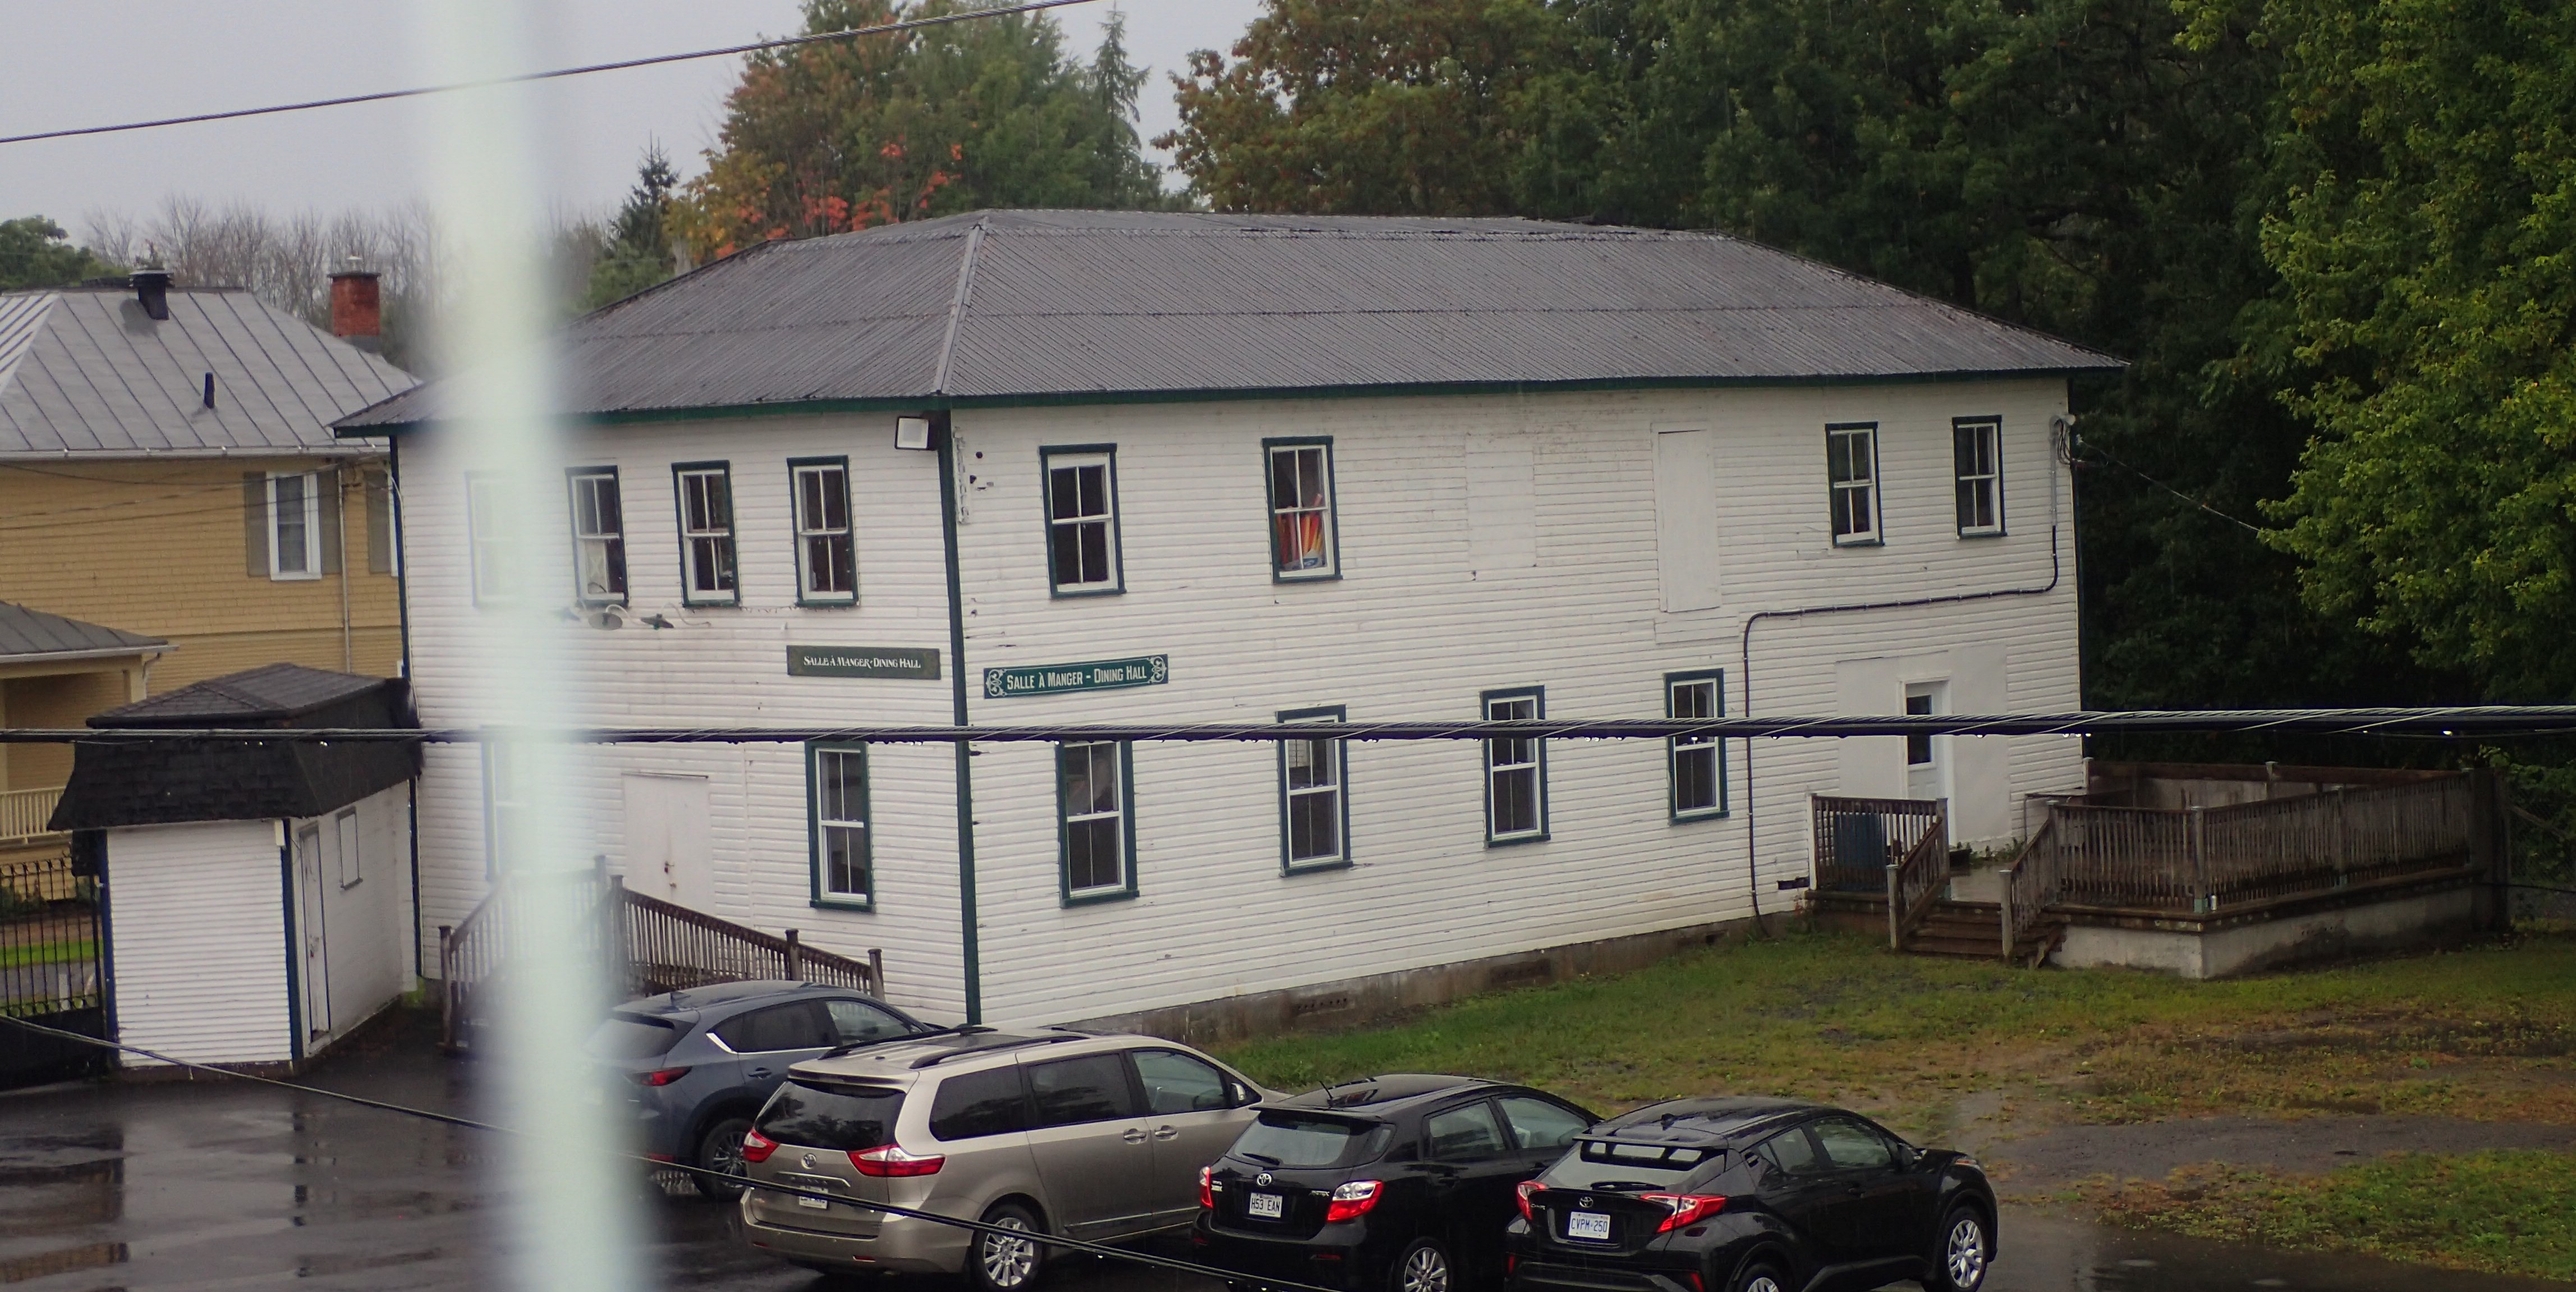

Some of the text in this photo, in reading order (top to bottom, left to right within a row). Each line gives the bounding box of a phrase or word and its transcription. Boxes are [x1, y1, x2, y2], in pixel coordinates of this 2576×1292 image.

[803, 656, 830, 666] SALLE
[899, 658, 921, 668] HALL
[1007, 675, 1035, 690] SALLE
[1038, 672, 1045, 688] À
[1048, 671, 1083, 688] MANGER
[1094, 668, 1124, 684] DINING
[1126, 665, 1147, 681] HALL
[1251, 1198, 1280, 1212] H53 EAN
